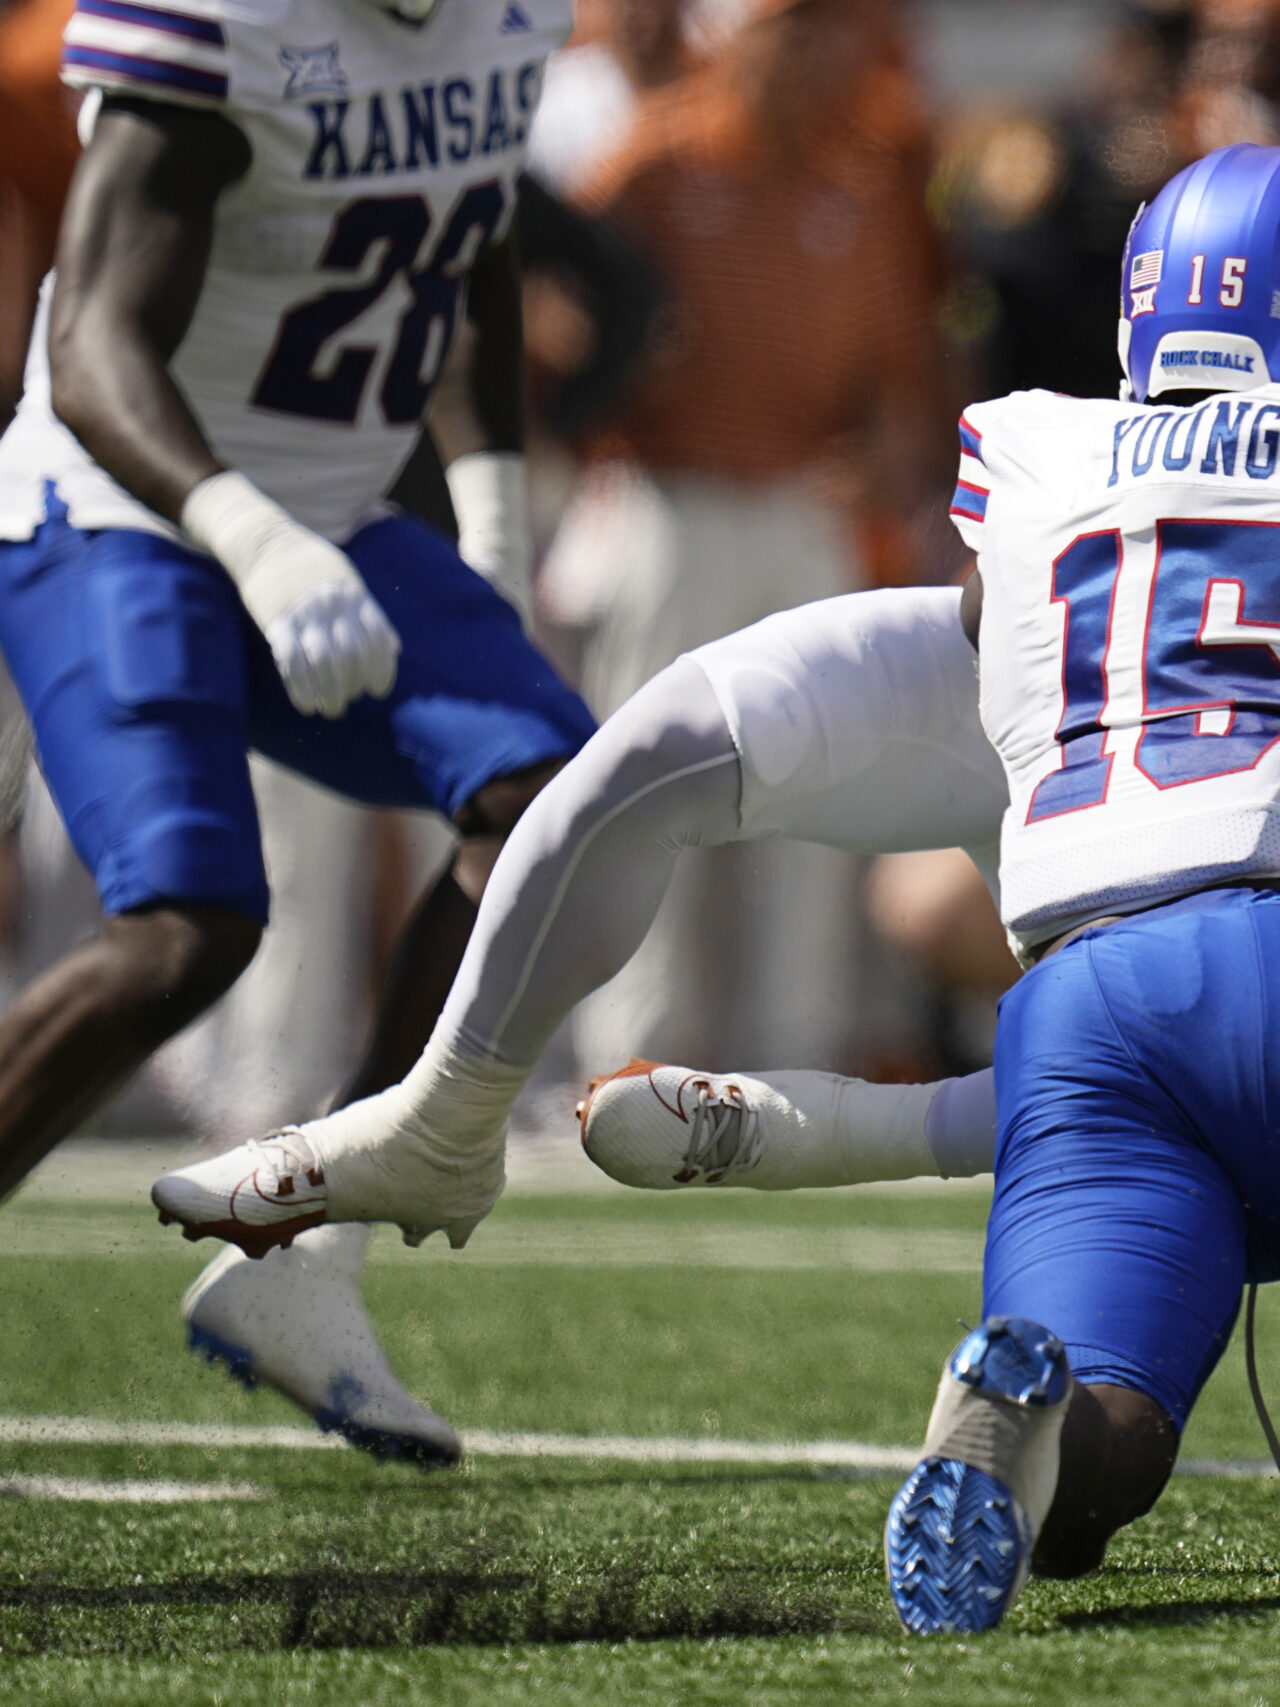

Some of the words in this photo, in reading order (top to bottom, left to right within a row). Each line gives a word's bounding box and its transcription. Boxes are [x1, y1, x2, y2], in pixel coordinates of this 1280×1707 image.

[250, 180, 503, 426] 28
[1187, 253, 1248, 309] 15
[1201, 350, 1255, 374] CHALK
